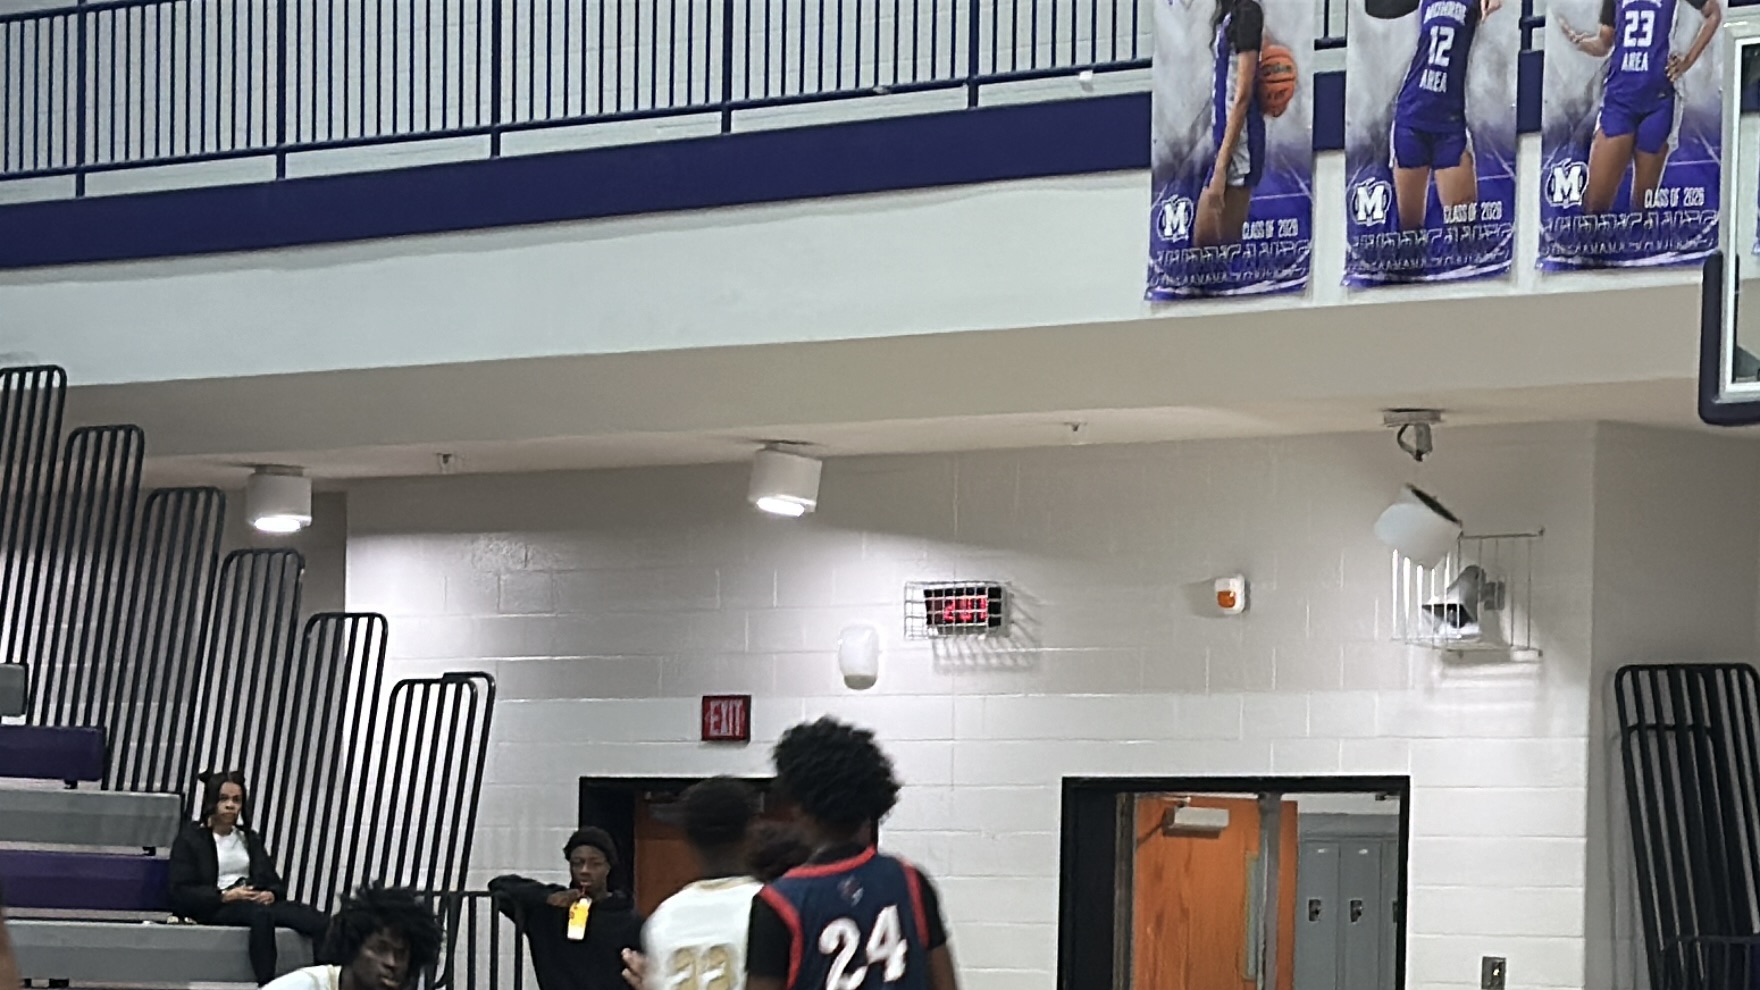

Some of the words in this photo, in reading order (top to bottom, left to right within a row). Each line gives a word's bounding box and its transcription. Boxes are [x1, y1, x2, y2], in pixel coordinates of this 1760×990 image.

[1428, 26, 1455, 66] 12
[1623, 10, 1655, 47] 23
[1621, 52, 1648, 72] AREA
[1553, 166, 1581, 202] M
[1644, 188, 1669, 208] CLASS
[1670, 187, 1681, 207] OF
[1163, 201, 1187, 237] M
[1357, 185, 1385, 221] M
[1444, 205, 1467, 225] CLASS
[1468, 203, 1477, 222] OF
[1242, 221, 1264, 240] CLASS
[1265, 220, 1275, 239] OF
[709, 699, 744, 738] EXIT
